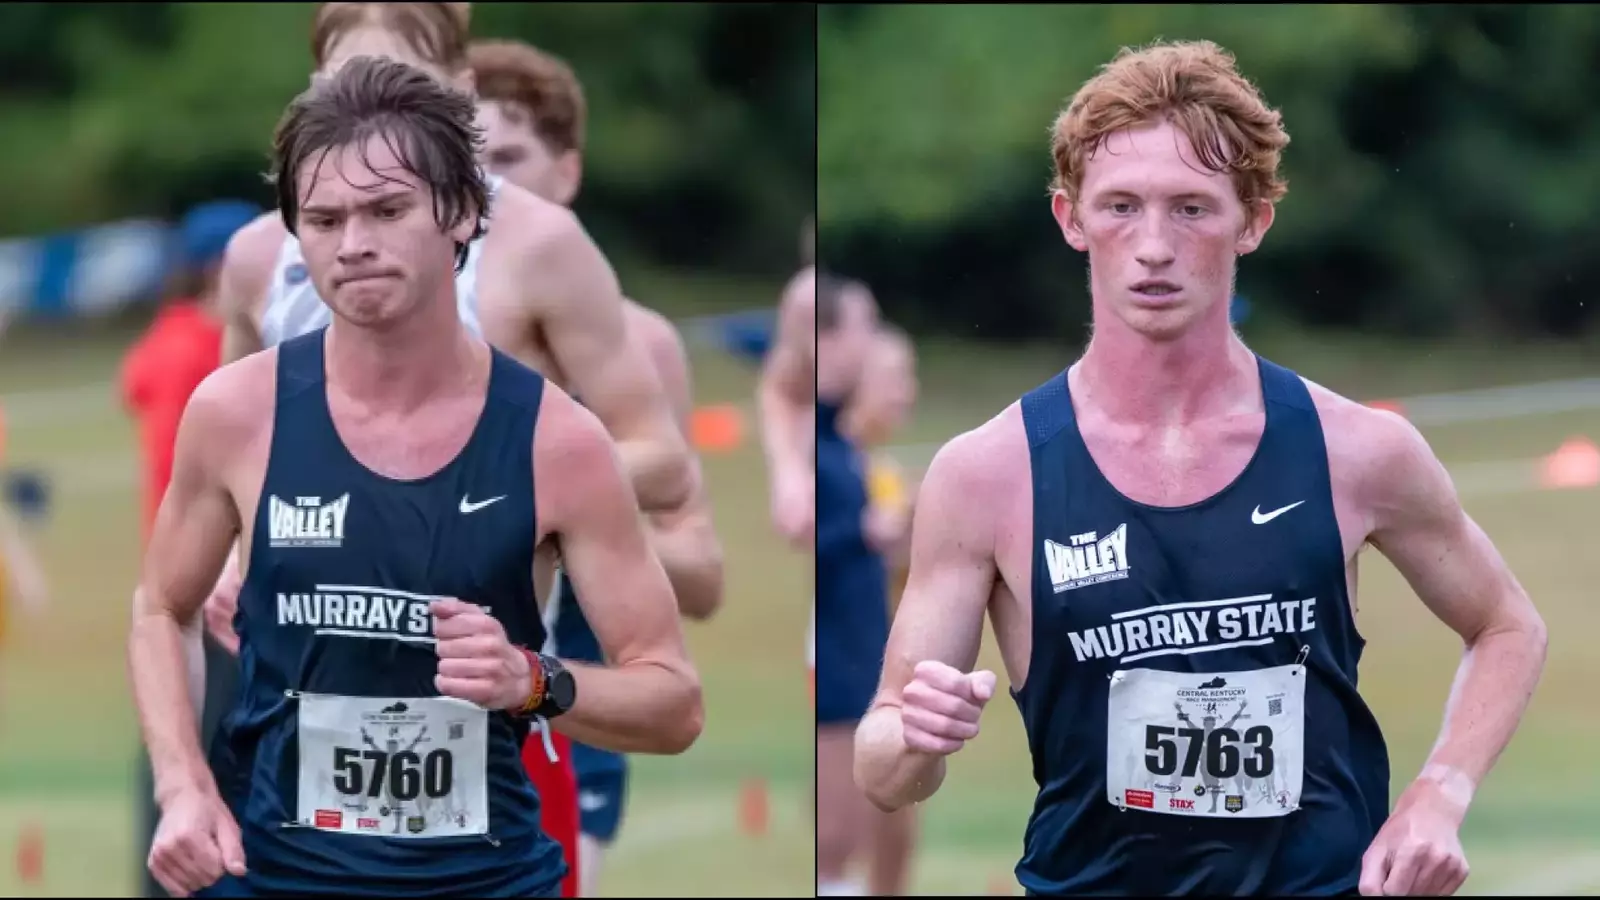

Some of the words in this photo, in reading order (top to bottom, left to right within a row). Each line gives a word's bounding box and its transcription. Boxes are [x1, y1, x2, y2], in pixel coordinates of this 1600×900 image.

[268, 493, 350, 539] VALLEY
[1070, 531, 1098, 546] THE
[1044, 523, 1128, 585] VALLEY
[277, 592, 407, 631] MURRAY
[1067, 611, 1211, 662] MURRAY
[1217, 597, 1317, 640] STATE
[1210, 688, 1247, 696] KENTUCKY
[333, 746, 453, 801] 5760
[1145, 724, 1274, 779] 5763
[1169, 798, 1195, 809] STAX
